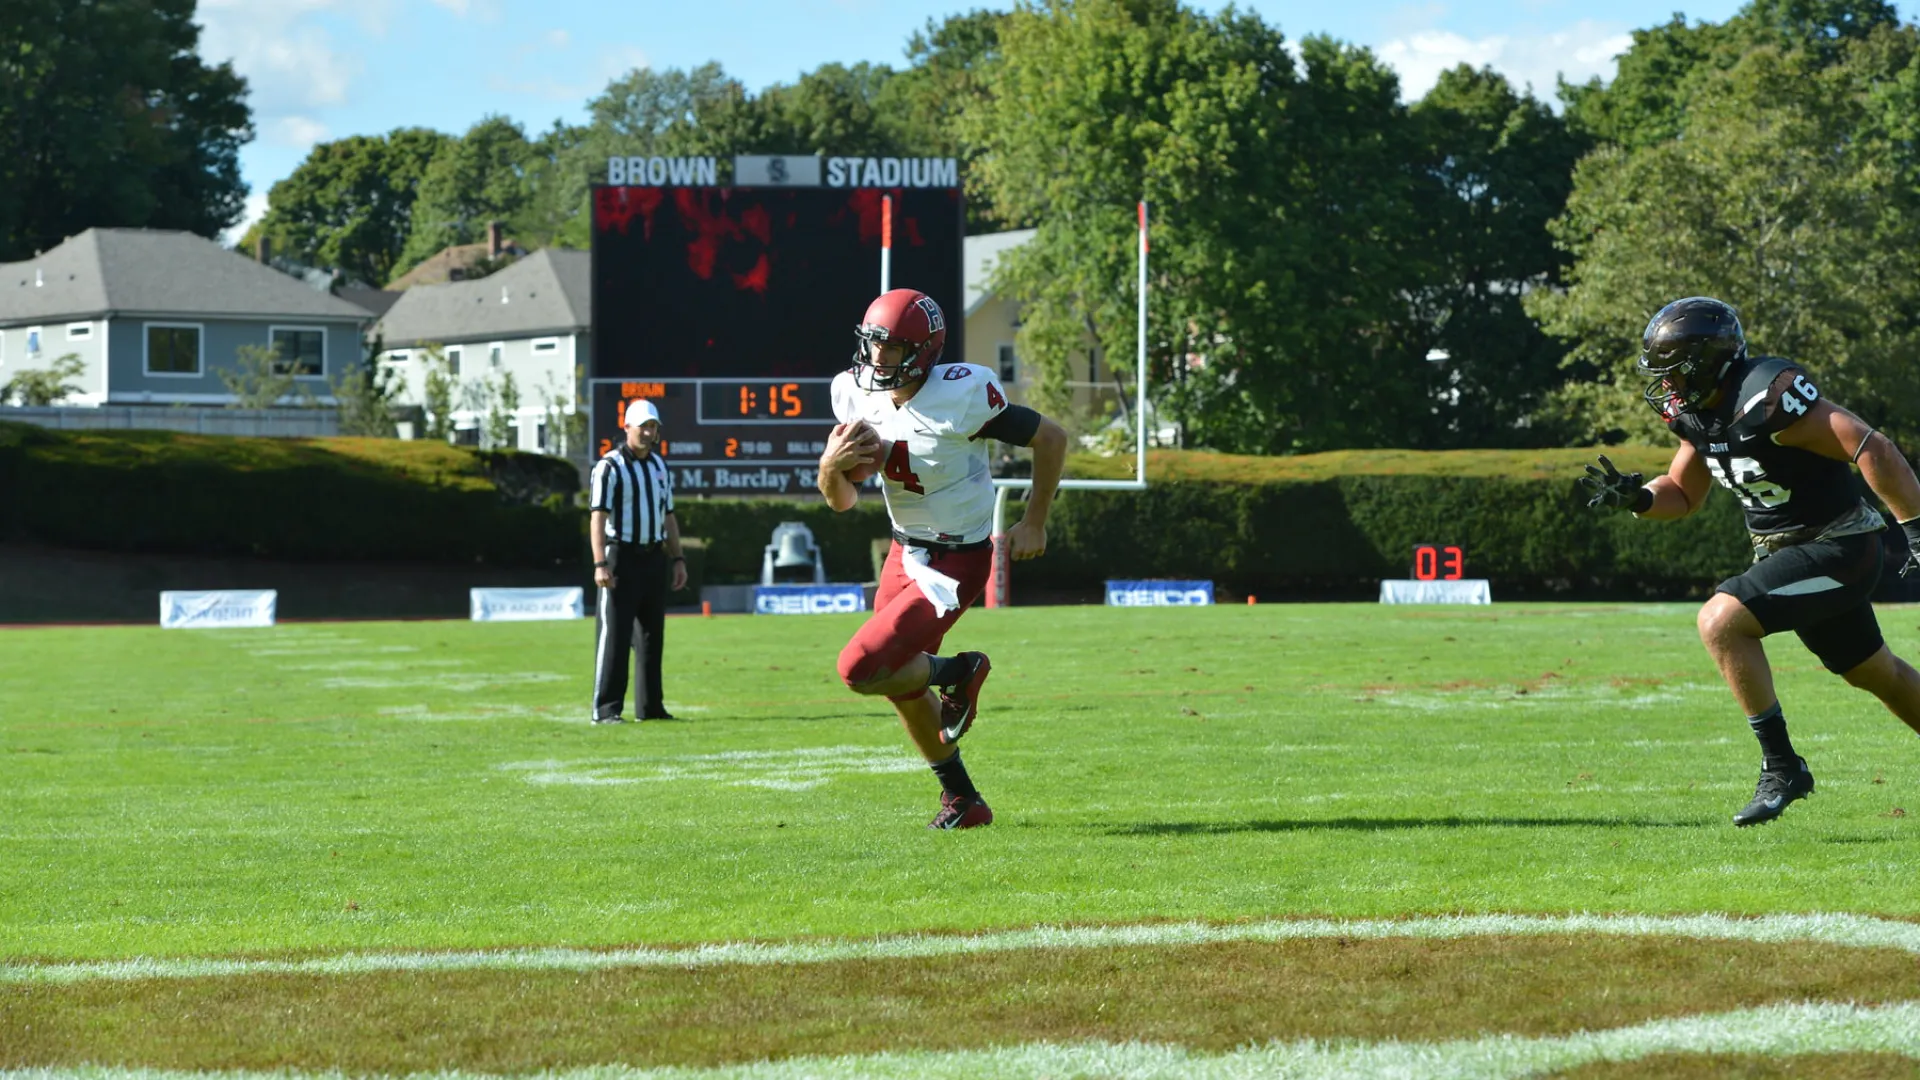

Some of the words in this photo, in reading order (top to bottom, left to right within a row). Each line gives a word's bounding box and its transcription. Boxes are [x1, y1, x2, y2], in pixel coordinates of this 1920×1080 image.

[608, 156, 716, 186] BROWN
[827, 157, 957, 187] STADIUM
[915, 297, 944, 333] H
[740, 383, 801, 417] 1:15
[986, 380, 1006, 410] 4
[1781, 375, 1819, 416] 46
[669, 442, 702, 454] DOWN
[725, 438, 738, 457] 2
[741, 441, 755, 454] TO
[756, 441, 772, 454] GO
[681, 469, 711, 488] M.
[715, 467, 791, 492] Barclay
[884, 440, 925, 495] 4
[1416, 546, 1463, 581] 03
[757, 593, 858, 614] GEICO
[1110, 589, 1209, 606] GEICO
